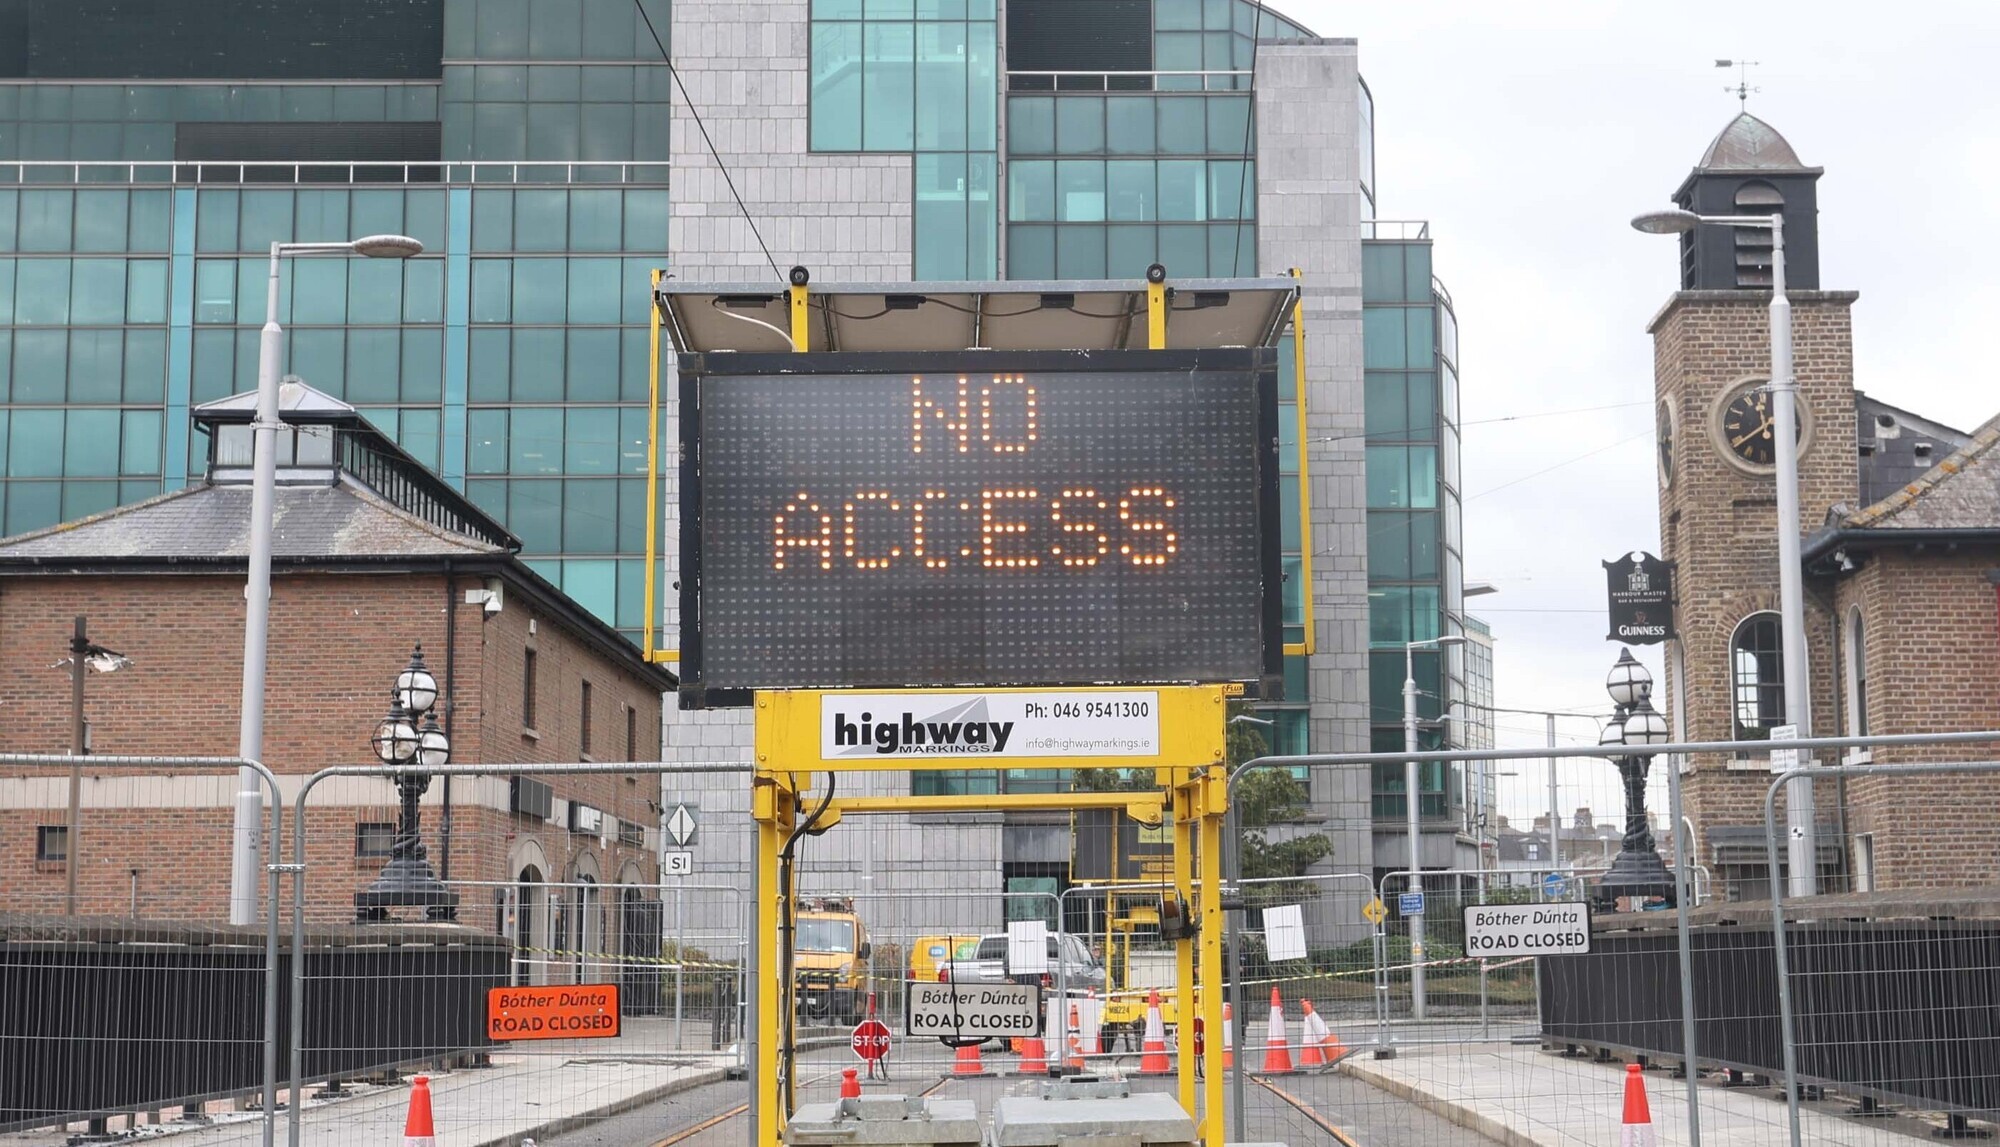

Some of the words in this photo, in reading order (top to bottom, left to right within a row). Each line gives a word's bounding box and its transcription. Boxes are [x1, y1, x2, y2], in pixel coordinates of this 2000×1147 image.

[912, 377, 1037, 453] NO
[775, 489, 1177, 570] ACCESS
[1618, 624, 1665, 636] GUINNESS
[1025, 703, 1048, 718] Ph:
[1053, 702, 1080, 718] 046
[1085, 702, 1149, 717] 9541300
[835, 712, 1014, 754] highway
[900, 745, 990, 753] MARKINGS
[1025, 738, 1150, 751] info@highwaymarkings.ie
[1476, 912, 1528, 926] Bóther
[1533, 911, 1578, 924] Dúnta
[1470, 935, 1519, 949] ROAD
[1524, 933, 1585, 947] CLOSED
[499, 993, 554, 1009] Bóther
[560, 992, 607, 1006] Dúnta
[921, 990, 975, 1004] Bóther
[980, 990, 1027, 1005] Dúnta
[492, 1017, 544, 1032] ROAD
[549, 1014, 612, 1030] CLOSED
[914, 1013, 965, 1028] ROAD
[969, 1014, 1034, 1029] CLOSED
[853, 1035, 890, 1047] STOP
